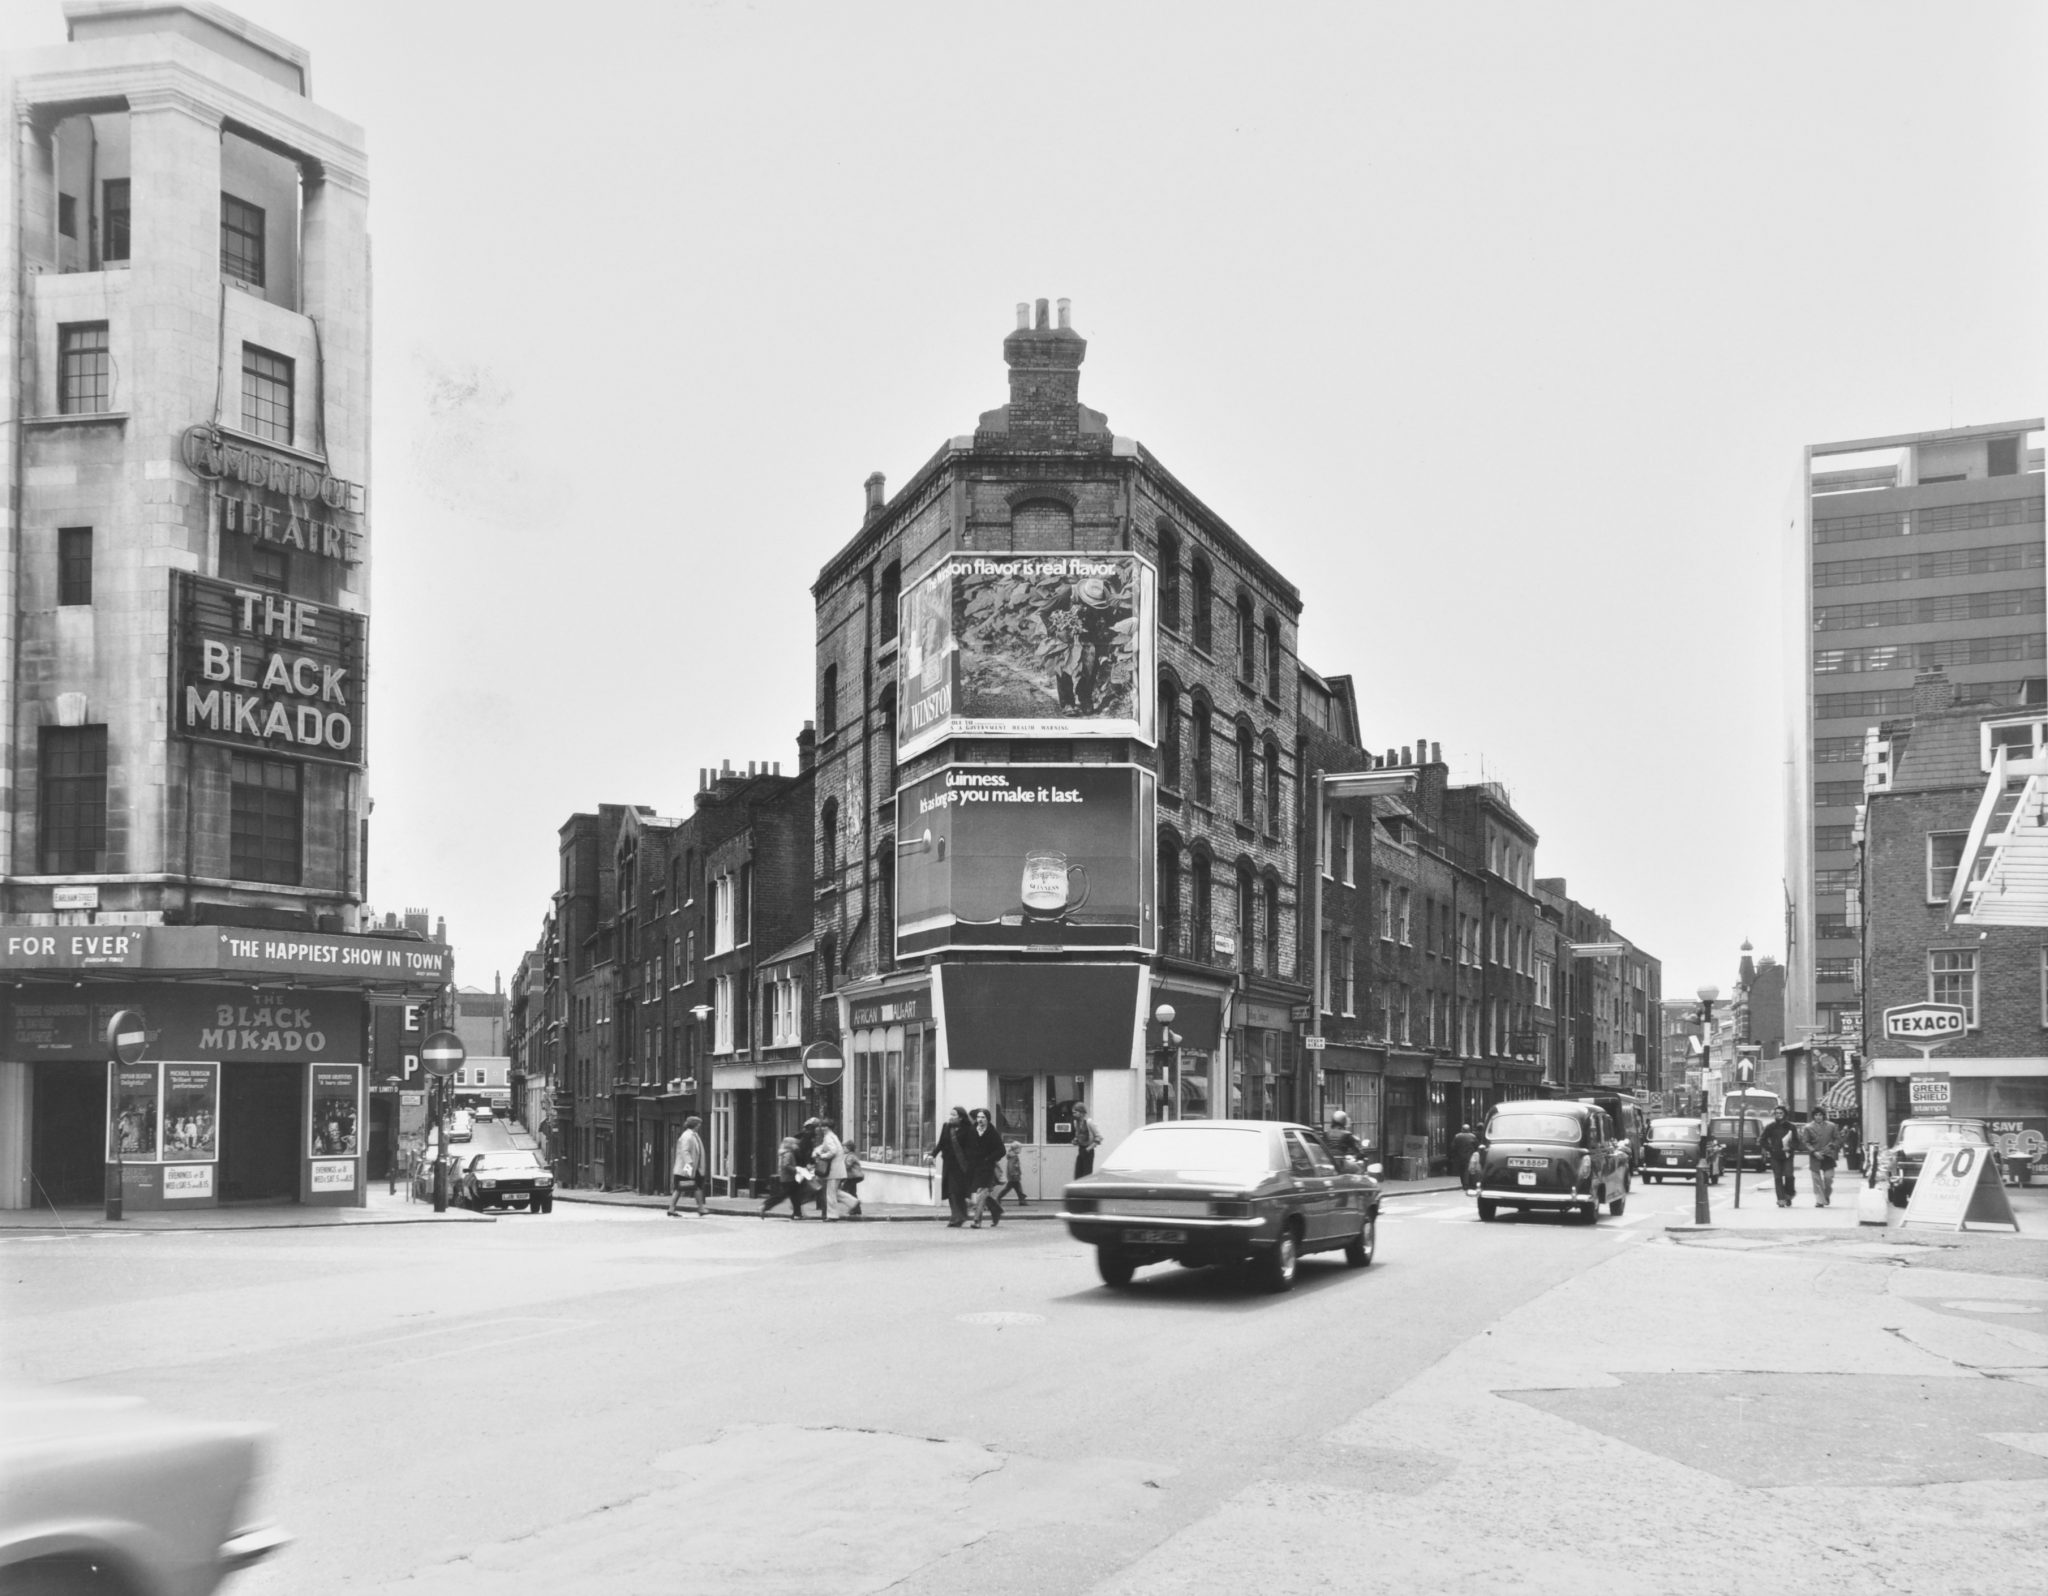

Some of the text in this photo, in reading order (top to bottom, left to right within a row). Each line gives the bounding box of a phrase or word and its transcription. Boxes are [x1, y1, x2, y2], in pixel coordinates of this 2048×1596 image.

[182, 424, 366, 515] CAMBRIDGE
[215, 494, 364, 564] THEATRE
[974, 558, 1021, 576] flavor
[1023, 559, 1034, 576] is
[1036, 559, 1067, 576] real
[1069, 558, 1116, 576] flavor.
[235, 588, 319, 645] THE
[203, 640, 347, 706] BLACK
[186, 685, 352, 750] MIKADO
[910, 684, 951, 731] WINSTON
[945, 770, 1010, 787] Guinness.
[947, 790, 958, 802] as
[960, 790, 989, 806] you
[992, 786, 1035, 802] make
[1038, 786, 1049, 802] it
[1052, 786, 1083, 803] last.
[8, 937, 56, 955] FOR
[265, 941, 339, 963] HAPPIEST
[342, 947, 383, 966] SHOW
[387, 951, 400, 967] IN
[253, 994, 284, 1005] THE
[216, 1005, 312, 1029] BLACK
[854, 1007, 878, 1025] AFRICAN
[1891, 1015, 1960, 1031] TEXACO
[199, 1029, 326, 1052] MIKADO
[1912, 1084, 1948, 1092] GREEN
[1912, 1093, 1948, 1101] SHIELD
[1914, 1104, 1948, 1113] stamps
[1993, 1122, 2024, 1131] SAVE
[1935, 1148, 1976, 1178] 20
